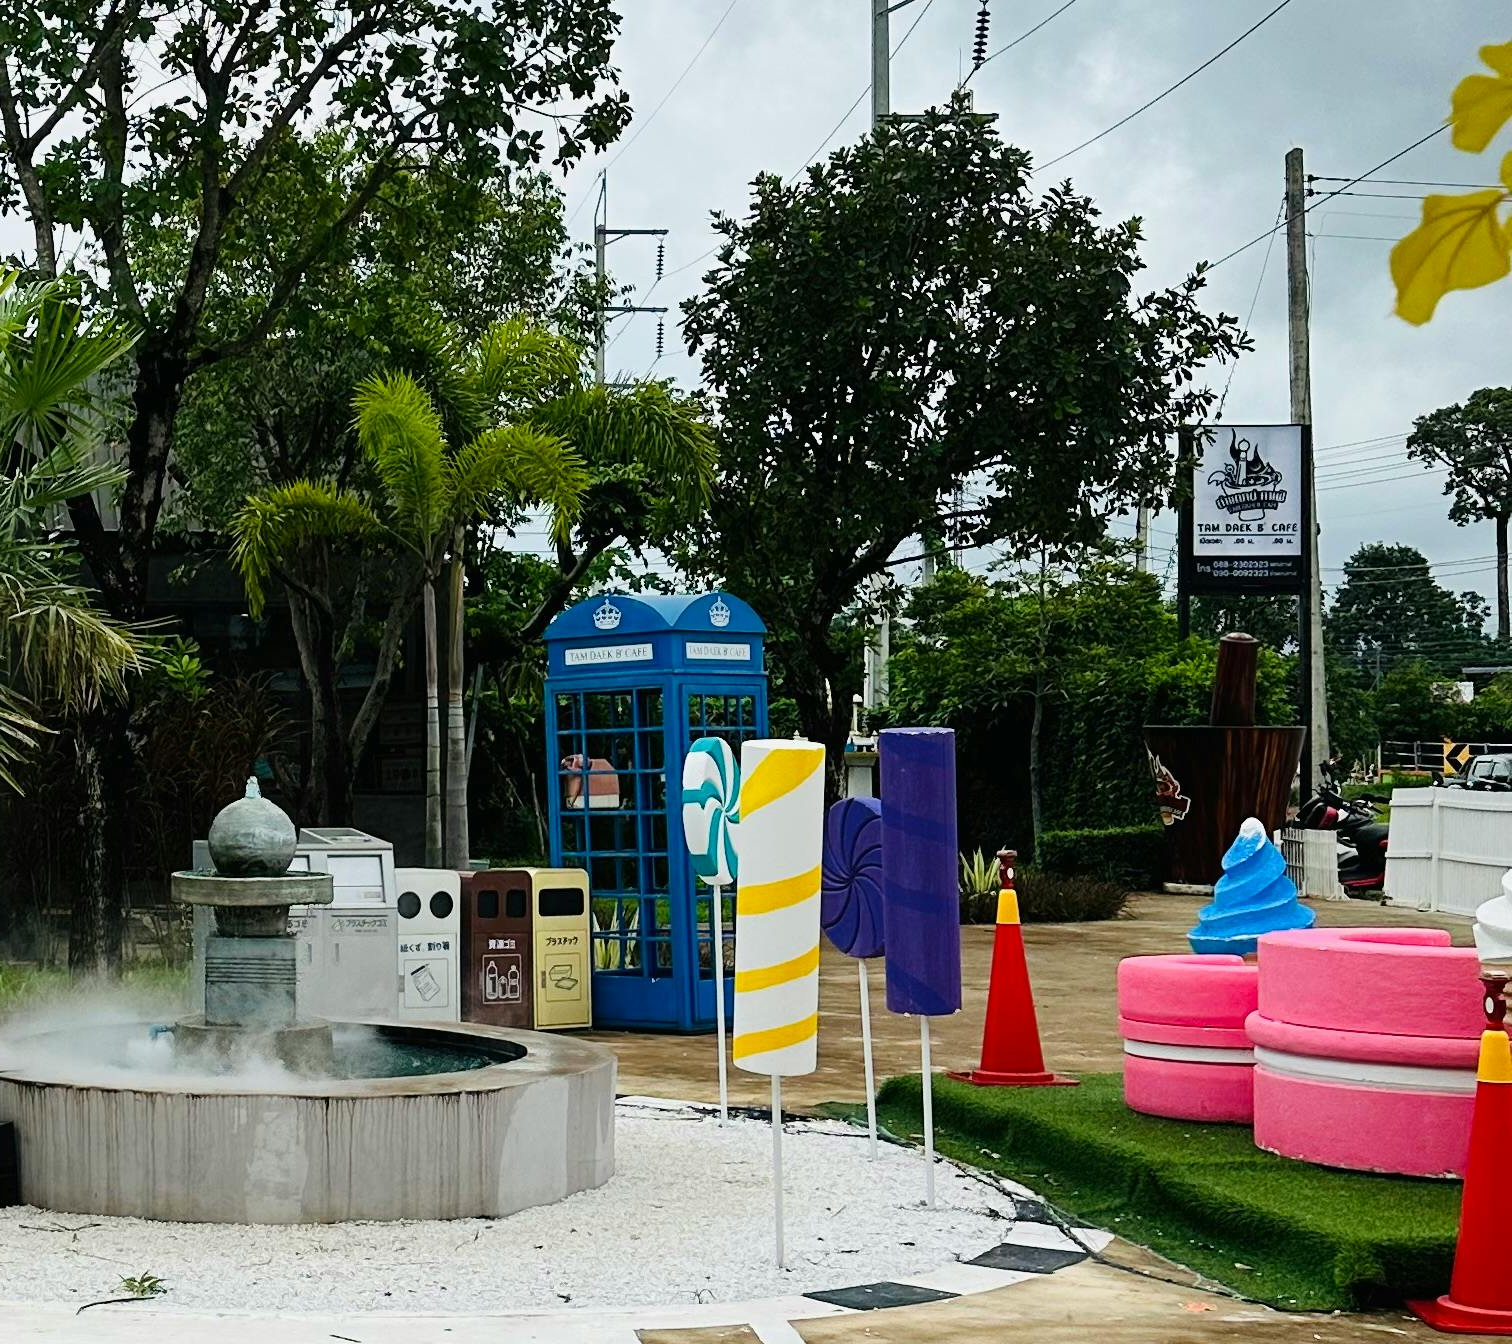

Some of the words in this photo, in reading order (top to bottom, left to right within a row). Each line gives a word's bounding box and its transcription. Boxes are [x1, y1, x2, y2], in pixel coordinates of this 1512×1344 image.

[1197, 524, 1220, 532] TAM
[1225, 524, 1252, 532] DAEK
[570, 652, 587, 662] TAM
[625, 647, 648, 657] CAFE
